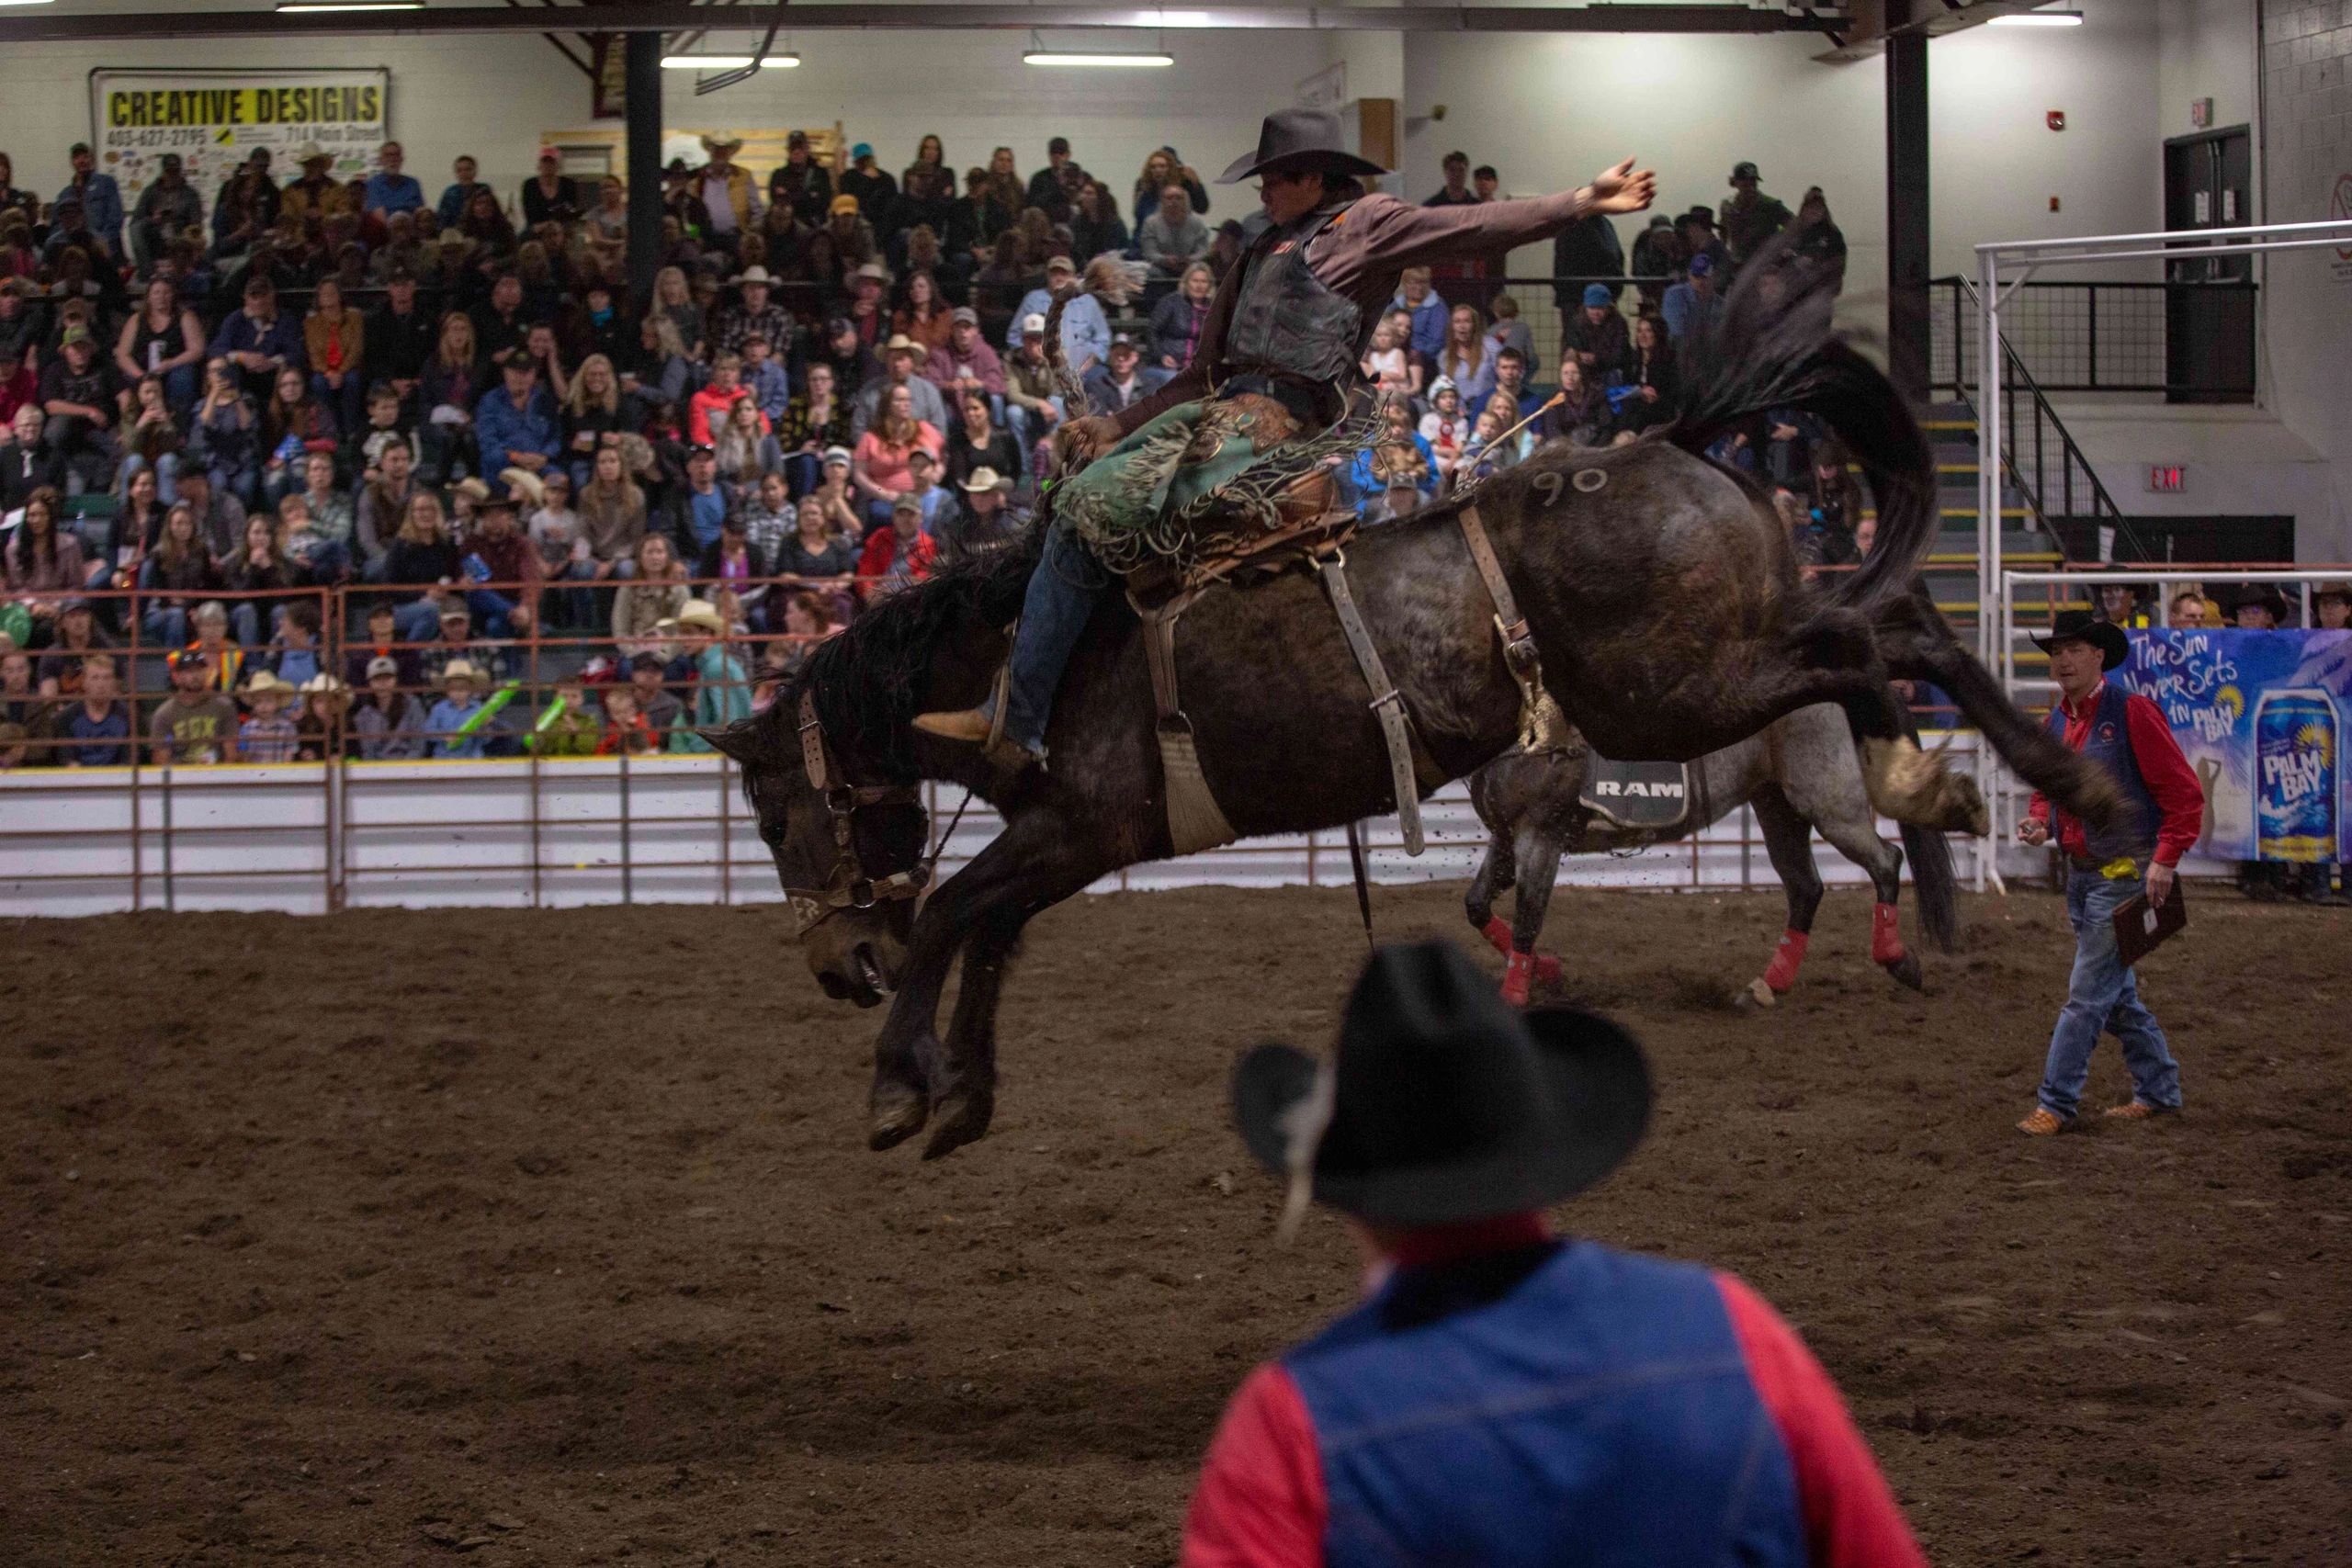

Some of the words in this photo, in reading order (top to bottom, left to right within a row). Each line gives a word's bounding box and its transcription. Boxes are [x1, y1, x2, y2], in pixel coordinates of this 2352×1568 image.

[111, 90, 243, 127] CREATIVE
[255, 86, 378, 123] DESIGNS
[1532, 468, 1608, 507] 90
[2152, 465, 2187, 491] EXIT
[2131, 633, 2167, 671] The
[2188, 648, 2238, 694] Sets
[2192, 704, 2234, 731] PALM
[2205, 717, 2233, 743] BAY
[2263, 750, 2321, 785] PALM
[1596, 781, 1683, 798] RAM
[2280, 768, 2322, 803] BAY
